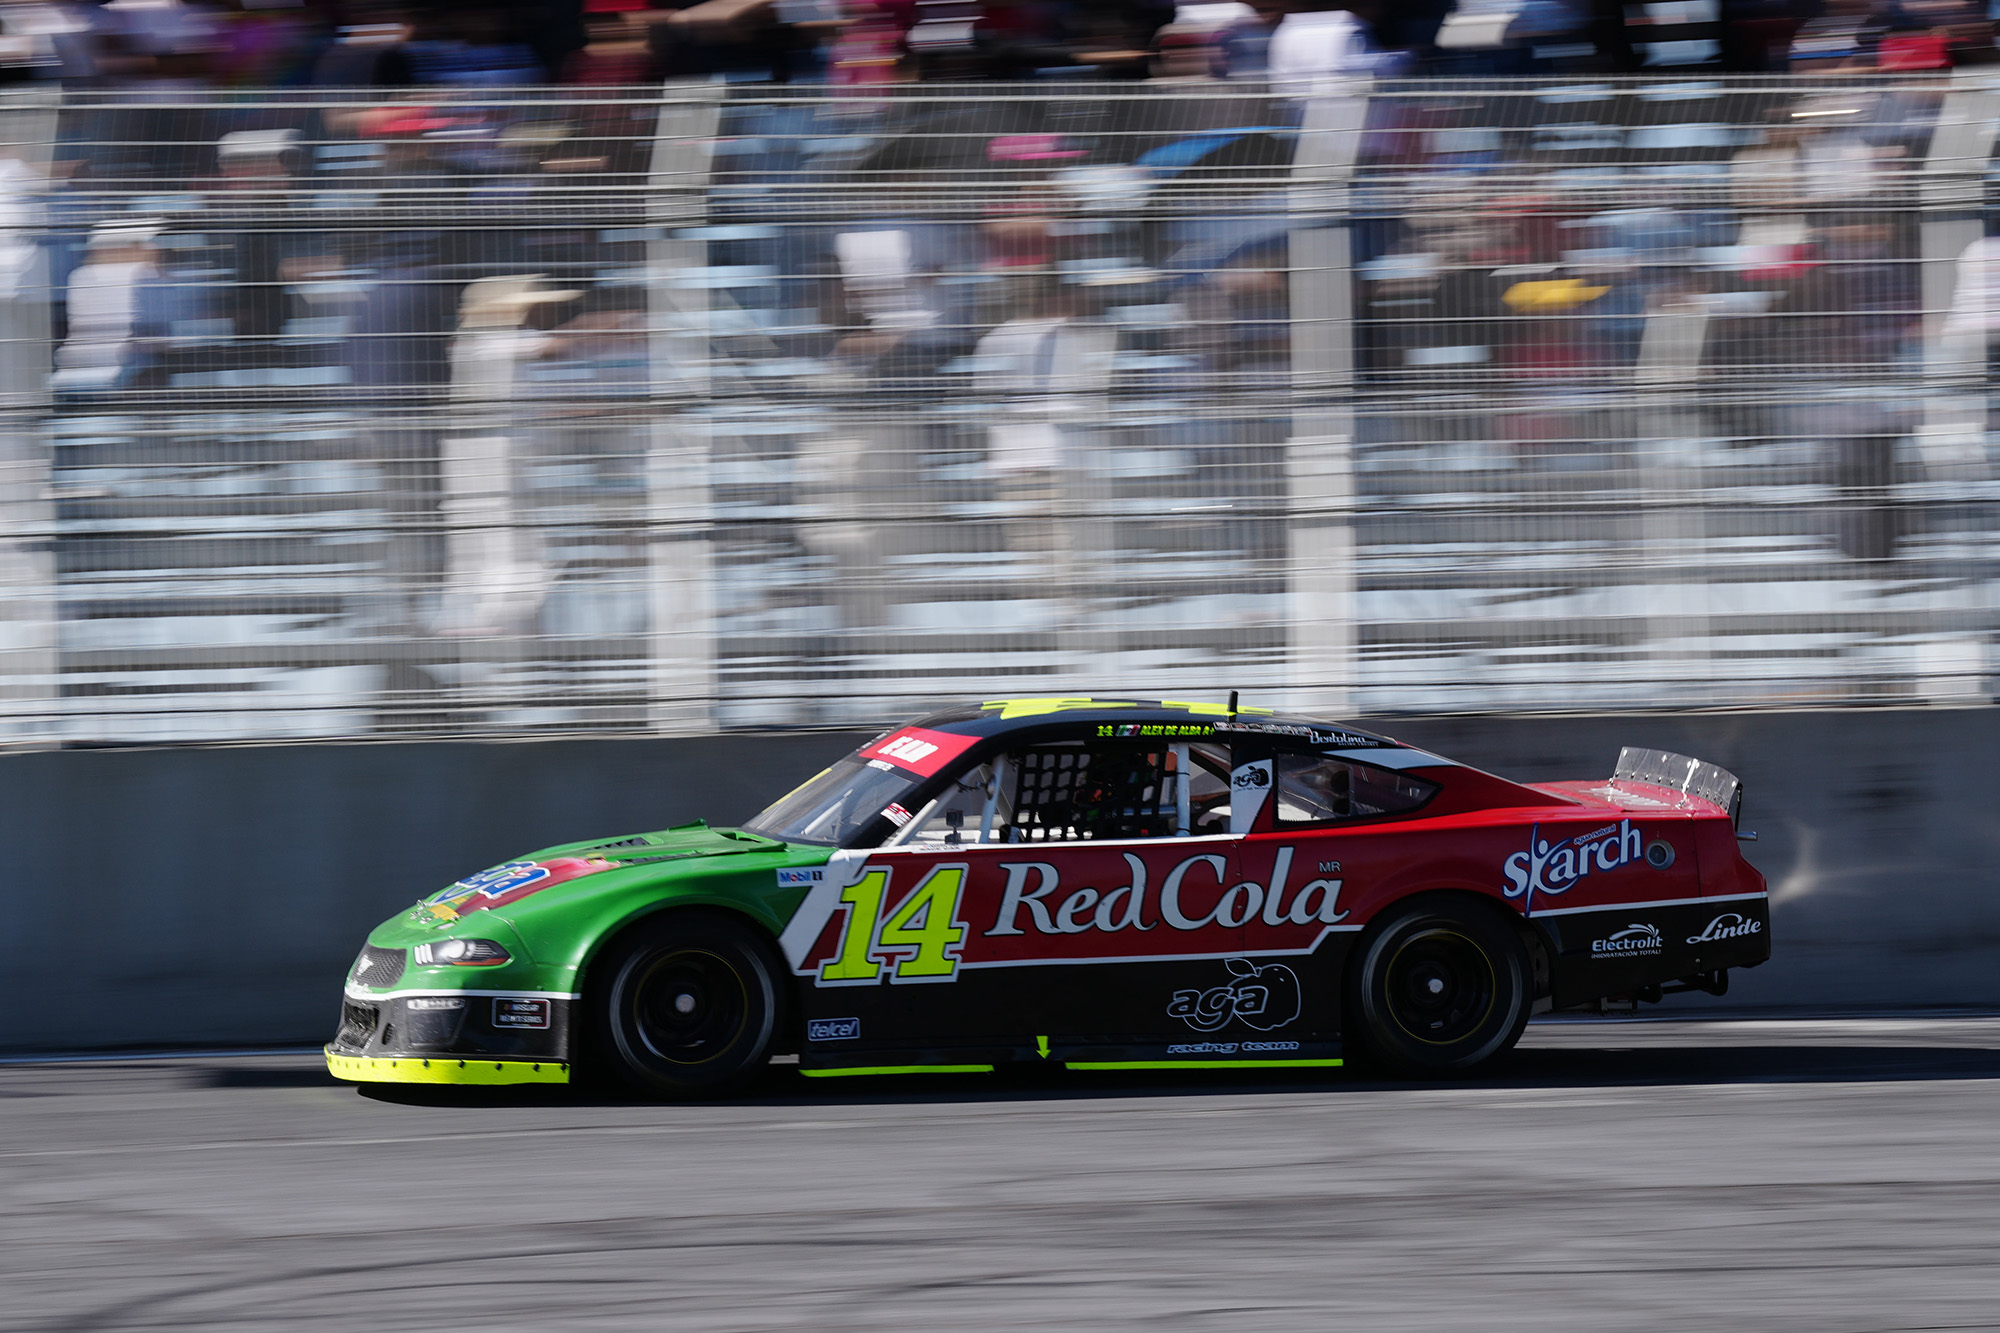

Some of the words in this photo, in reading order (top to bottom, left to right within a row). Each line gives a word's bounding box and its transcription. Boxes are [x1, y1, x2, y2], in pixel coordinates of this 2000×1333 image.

[1097, 724, 1113, 737] 14
[1140, 725, 1164, 736] ALEX
[1164, 725, 1178, 736] DE
[1178, 725, 1202, 736] ALBA
[1310, 731, 1367, 744] Bertolina
[1233, 772, 1261, 788] aga
[1318, 861, 1342, 873] MR
[780, 871, 812, 883] Mobil
[984, 852, 1158, 936] Red
[1160, 846, 1350, 930] Cola
[818, 866, 967, 984] 14
[1686, 913, 1762, 944] Linde
[1592, 936, 1663, 952] Electrolit
[1166, 986, 1269, 1032] aga
[811, 1021, 856, 1038] telcel
[1167, 1042, 1239, 1054] racing
[1241, 1041, 1300, 1051] team
